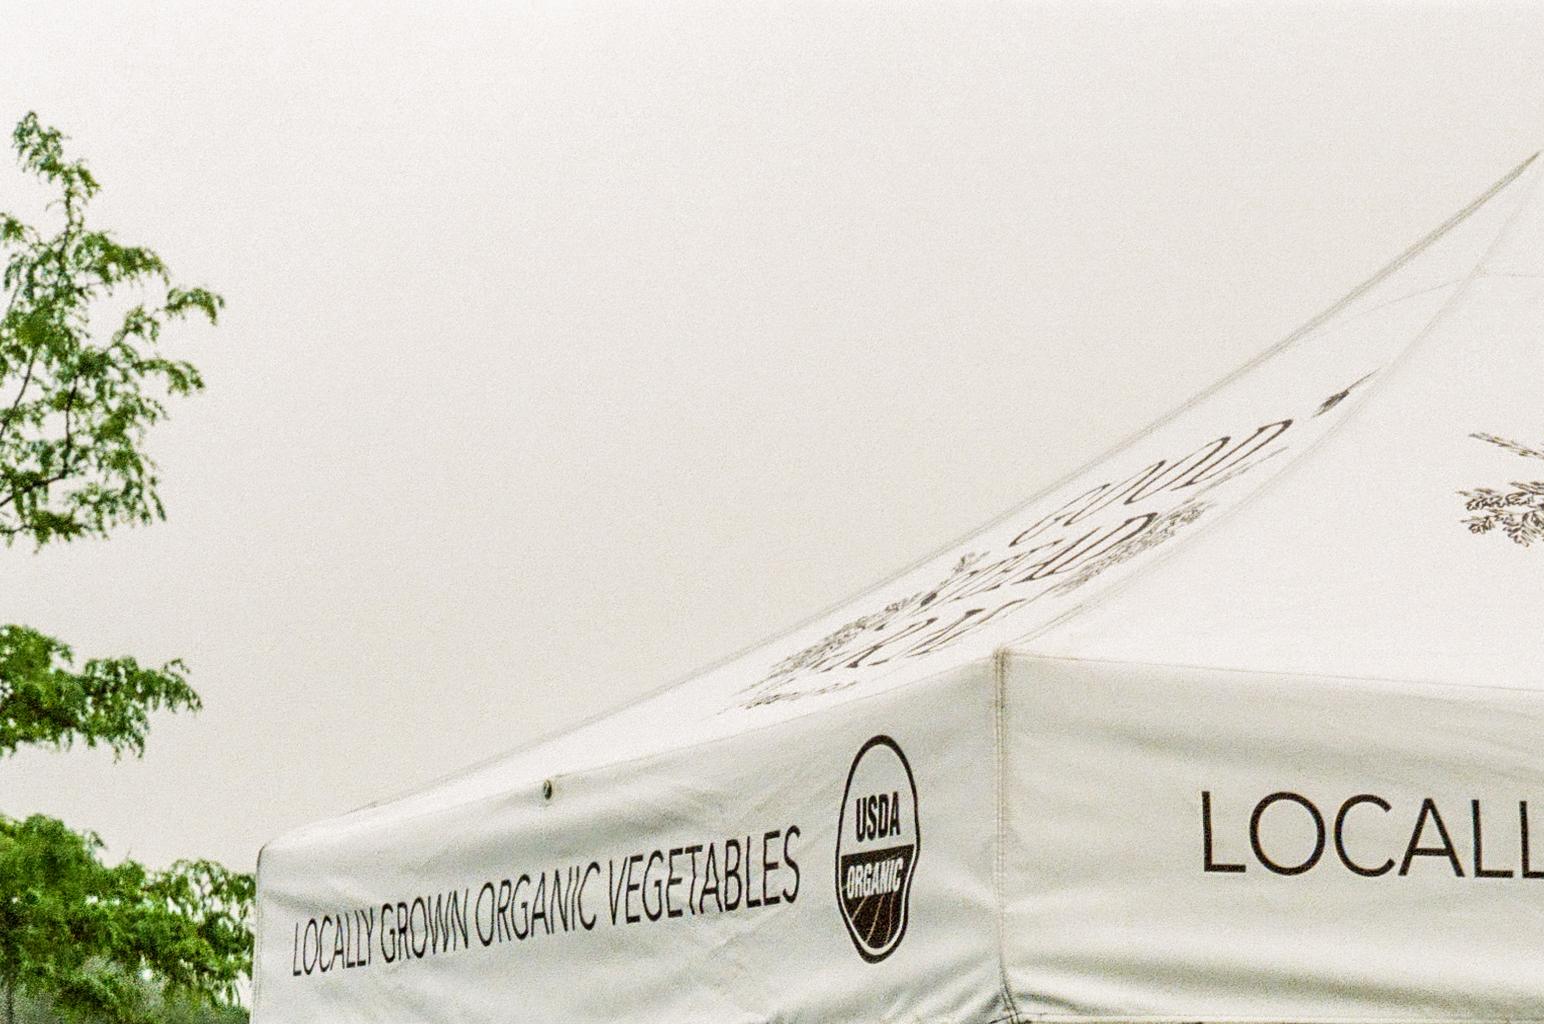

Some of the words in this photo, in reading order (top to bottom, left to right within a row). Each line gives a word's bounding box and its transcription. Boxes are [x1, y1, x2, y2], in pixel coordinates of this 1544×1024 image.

[856, 790, 901, 843] USDA
[292, 913, 377, 977] LOCALLY
[381, 889, 469, 964] GROWN
[476, 861, 601, 949] ORGANIC
[605, 824, 802, 926] VEGETABLES
[846, 857, 904, 900] ORGANIC
